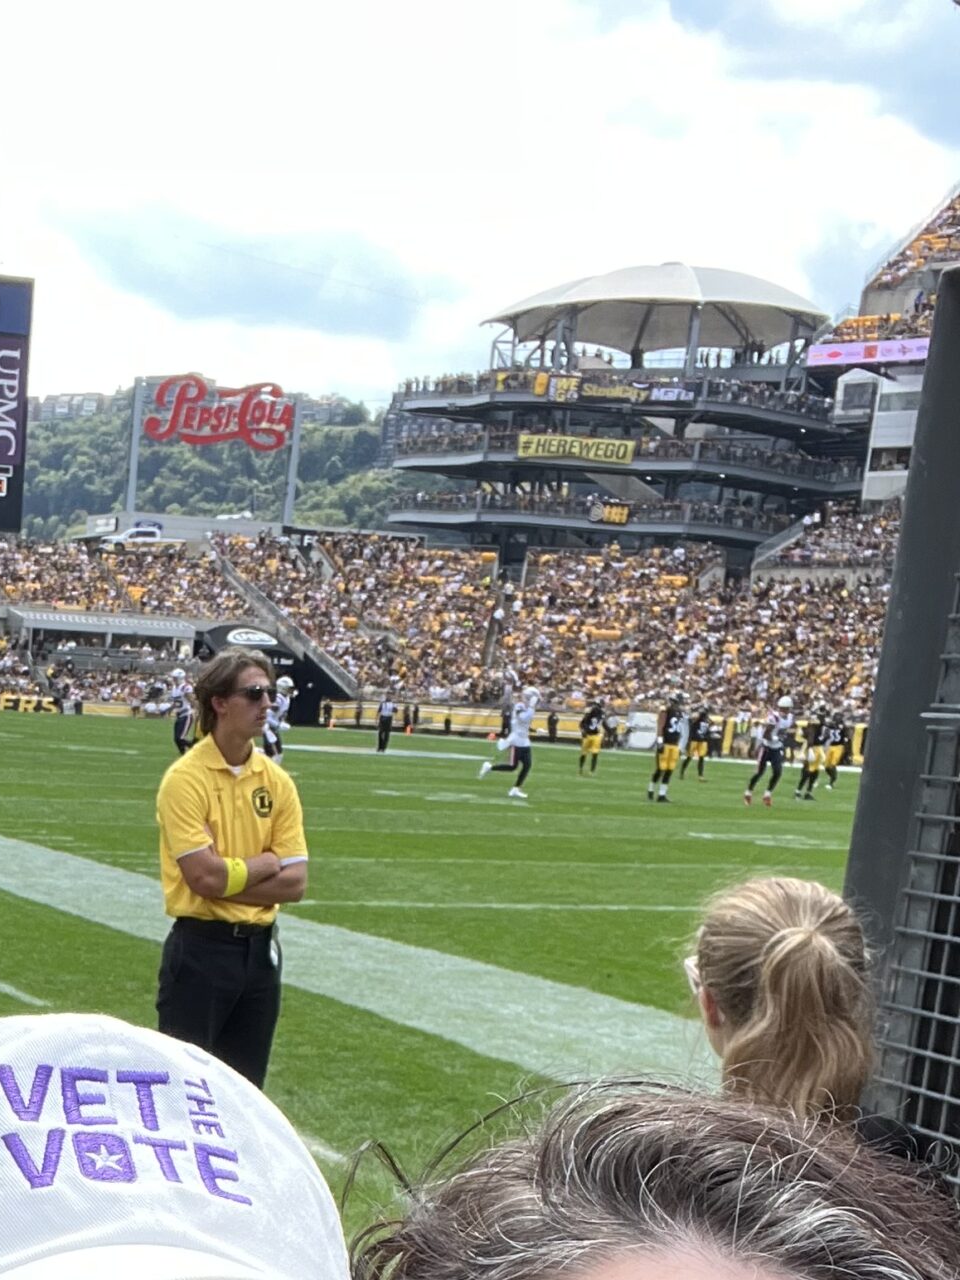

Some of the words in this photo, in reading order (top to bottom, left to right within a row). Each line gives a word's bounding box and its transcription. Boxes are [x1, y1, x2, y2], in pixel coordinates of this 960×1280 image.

[520, 437, 629, 461] #HEREWEGO
[183, 1077, 226, 1139] THE
[0, 1127, 253, 1207] VOTE
